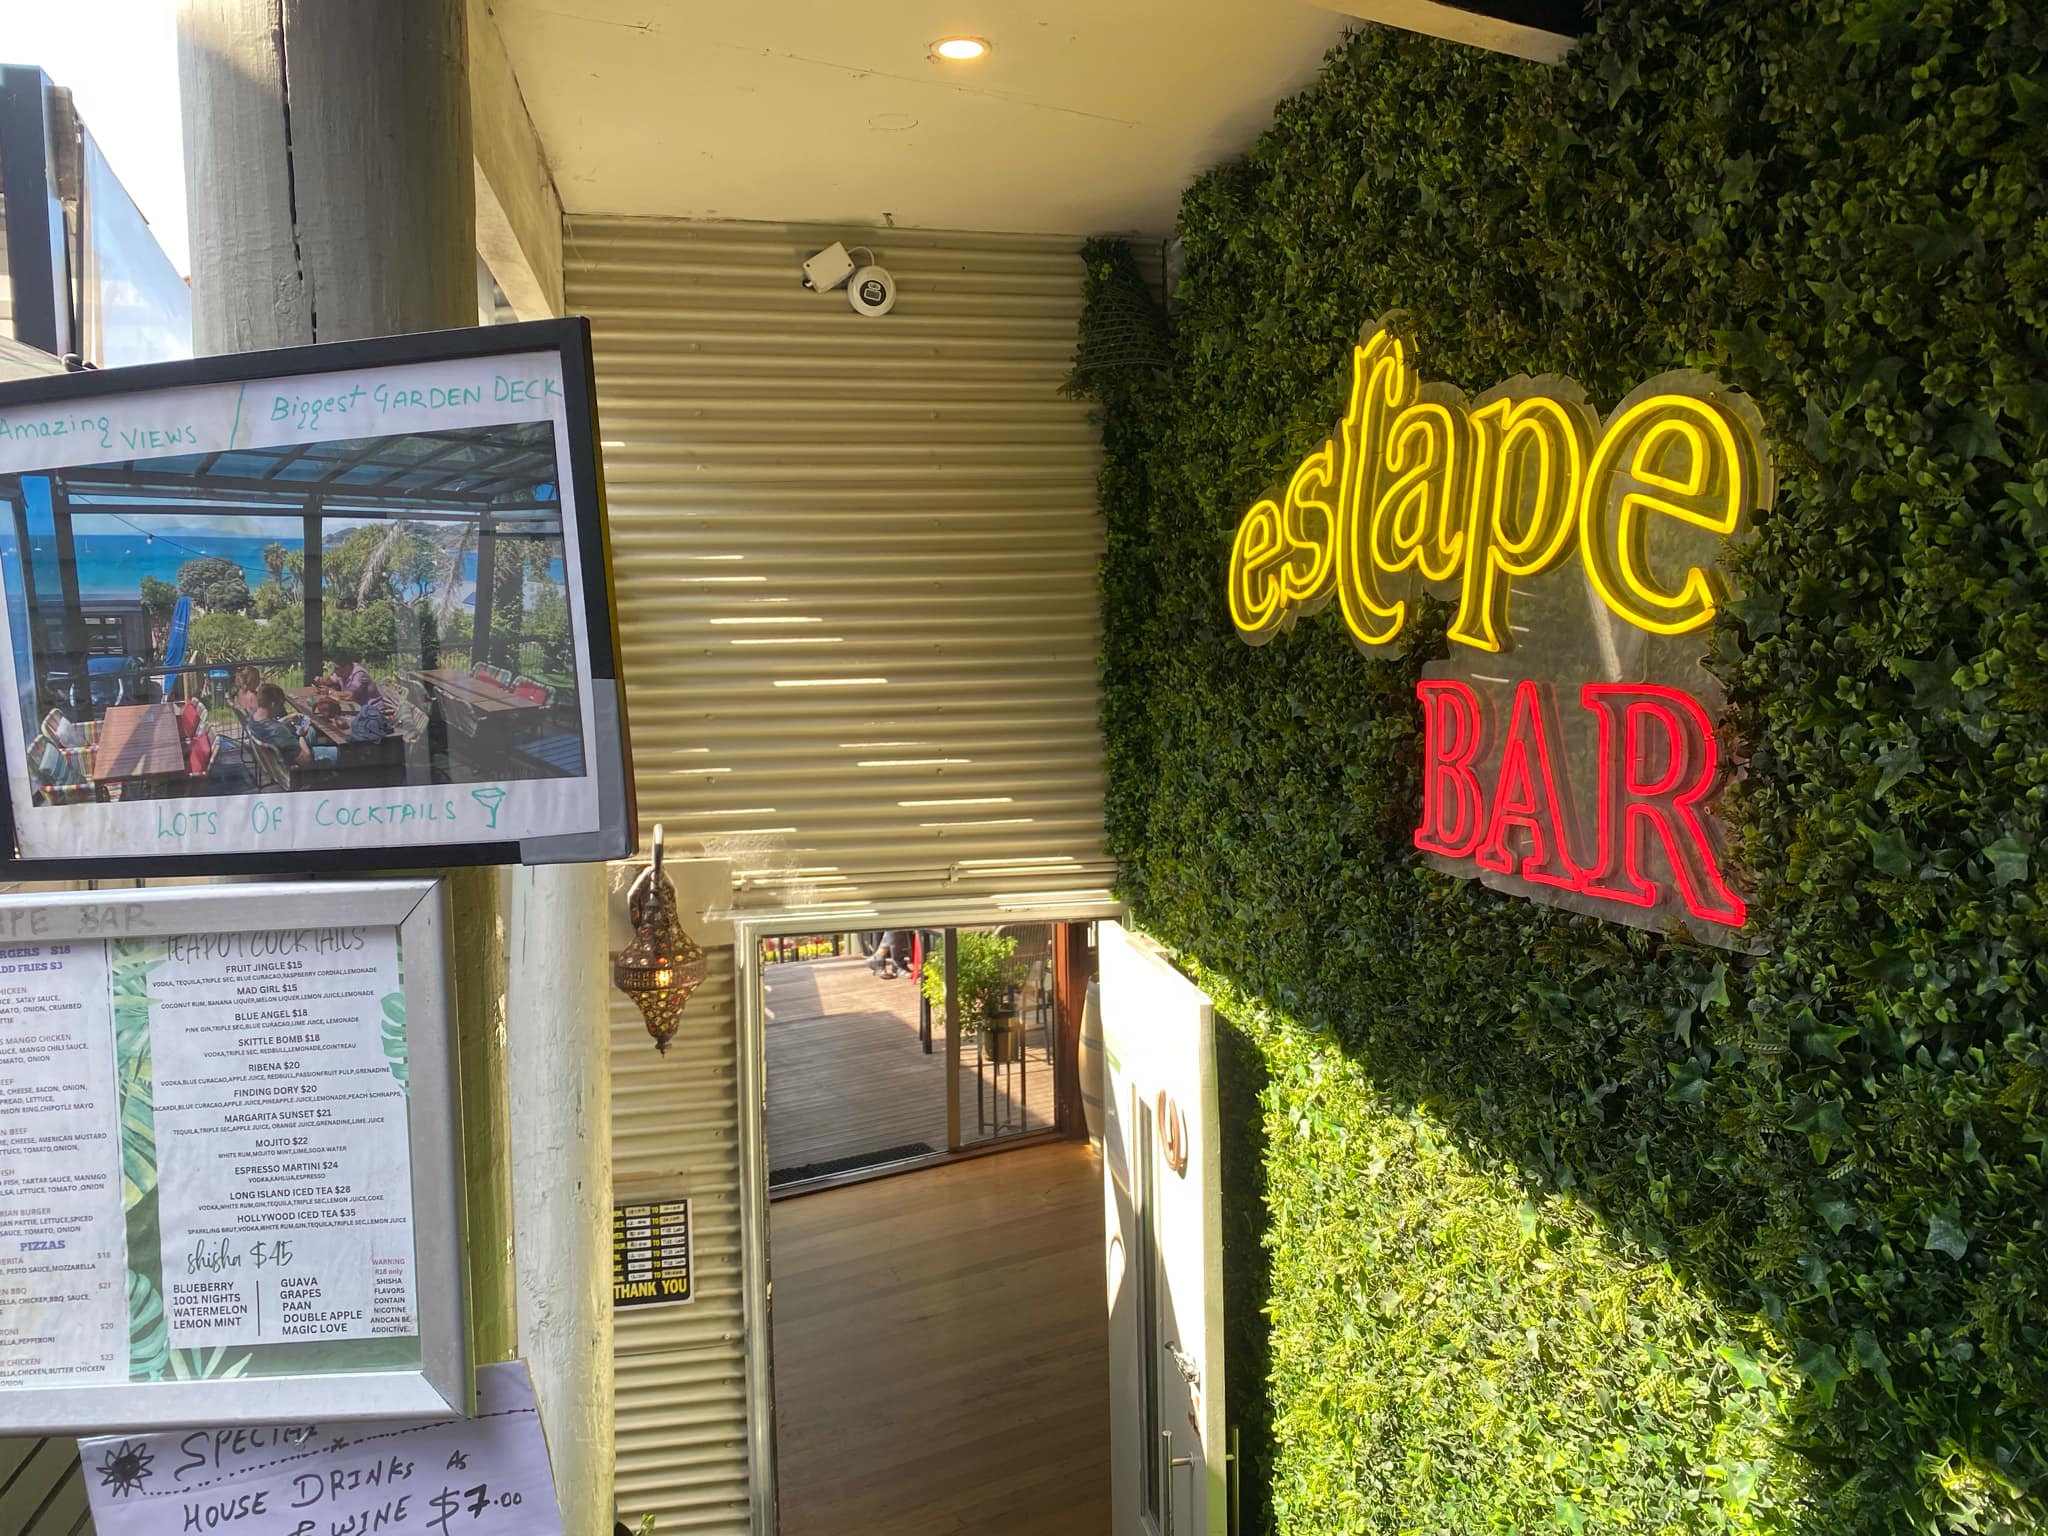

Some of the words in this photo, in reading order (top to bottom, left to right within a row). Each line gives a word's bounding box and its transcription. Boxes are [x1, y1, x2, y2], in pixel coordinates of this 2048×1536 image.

[271, 384, 366, 430] Biggest
[374, 383, 481, 413] GARDEN
[494, 375, 562, 401] DECK
[121, 425, 198, 449] VIEWS
[1229, 328, 1743, 653] escape
[1415, 680, 1746, 927] BAR
[158, 806, 217, 838] LOTS
[251, 800, 283, 834] OF
[315, 799, 456, 827] COCKTAILS
[18, 963, 48, 972] FRIES
[226, 964, 251, 973] FRUIT
[253, 962, 286, 972] JINGLE
[287, 961, 303, 969] $15
[237, 986, 257, 995] MAD
[259, 985, 280, 993] GIRL
[282, 984, 298, 992] $15
[235, 1012, 258, 1021] BLUE
[260, 1010, 290, 1019] ANGEL
[292, 1009, 308, 1017] $18
[6, 1036, 36, 1045] MANGO
[39, 1034, 71, 1042] CHICKEN
[238, 1037, 274, 1046] SKITTLE
[276, 1035, 303, 1044] BOMB
[305, 1034, 320, 1042] $18
[248, 1062, 282, 1072] RIBENA
[284, 1061, 300, 1070] $20
[234, 1088, 272, 1098] FINDING
[274, 1086, 299, 1095] DORY
[301, 1085, 317, 1094] $20
[224, 1112, 277, 1123] MARGARITA
[279, 1110, 315, 1119] SUNSET
[316, 1109, 331, 1118] $21
[255, 1138, 290, 1147] MOJITO
[292, 1137, 308, 1145] $22
[234, 1164, 280, 1175] ESPRESSO
[282, 1162, 320, 1172] MARTINI
[322, 1161, 338, 1170] $24
[230, 1190, 255, 1200] LONG
[257, 1188, 291, 1198] ISLAND
[292, 1188, 314, 1196] ICED
[316, 1187, 332, 1195] TEA
[237, 1212, 295, 1223] HOLLYWOOD
[297, 1211, 319, 1220] ICED
[321, 1210, 338, 1218] TEA
[340, 1209, 356, 1217] $35
[20, 1240, 65, 1252] PIZZAS
[187, 1237, 241, 1274] shisha
[249, 1240, 293, 1269] $45
[173, 1282, 234, 1293] BLUEBERRY
[280, 1277, 318, 1288] GUAVA
[614, 1281, 657, 1299] THANK
[662, 1278, 687, 1294] YOU
[173, 1296, 199, 1306] 1001
[201, 1294, 241, 1304] NIGHTS
[280, 1289, 322, 1299] GRAPES
[173, 1305, 248, 1317] WATERMELON
[282, 1301, 312, 1311] PAAN
[283, 1312, 327, 1323] DOUBLE
[329, 1310, 363, 1320] APPLE
[173, 1319, 212, 1329] LEMON
[214, 1317, 241, 1327] MINT
[282, 1324, 317, 1335] MAGIC
[320, 1323, 348, 1333] LOVE
[184, 1491, 269, 1532] HOUSE
[331, 1495, 412, 1536] WINE
